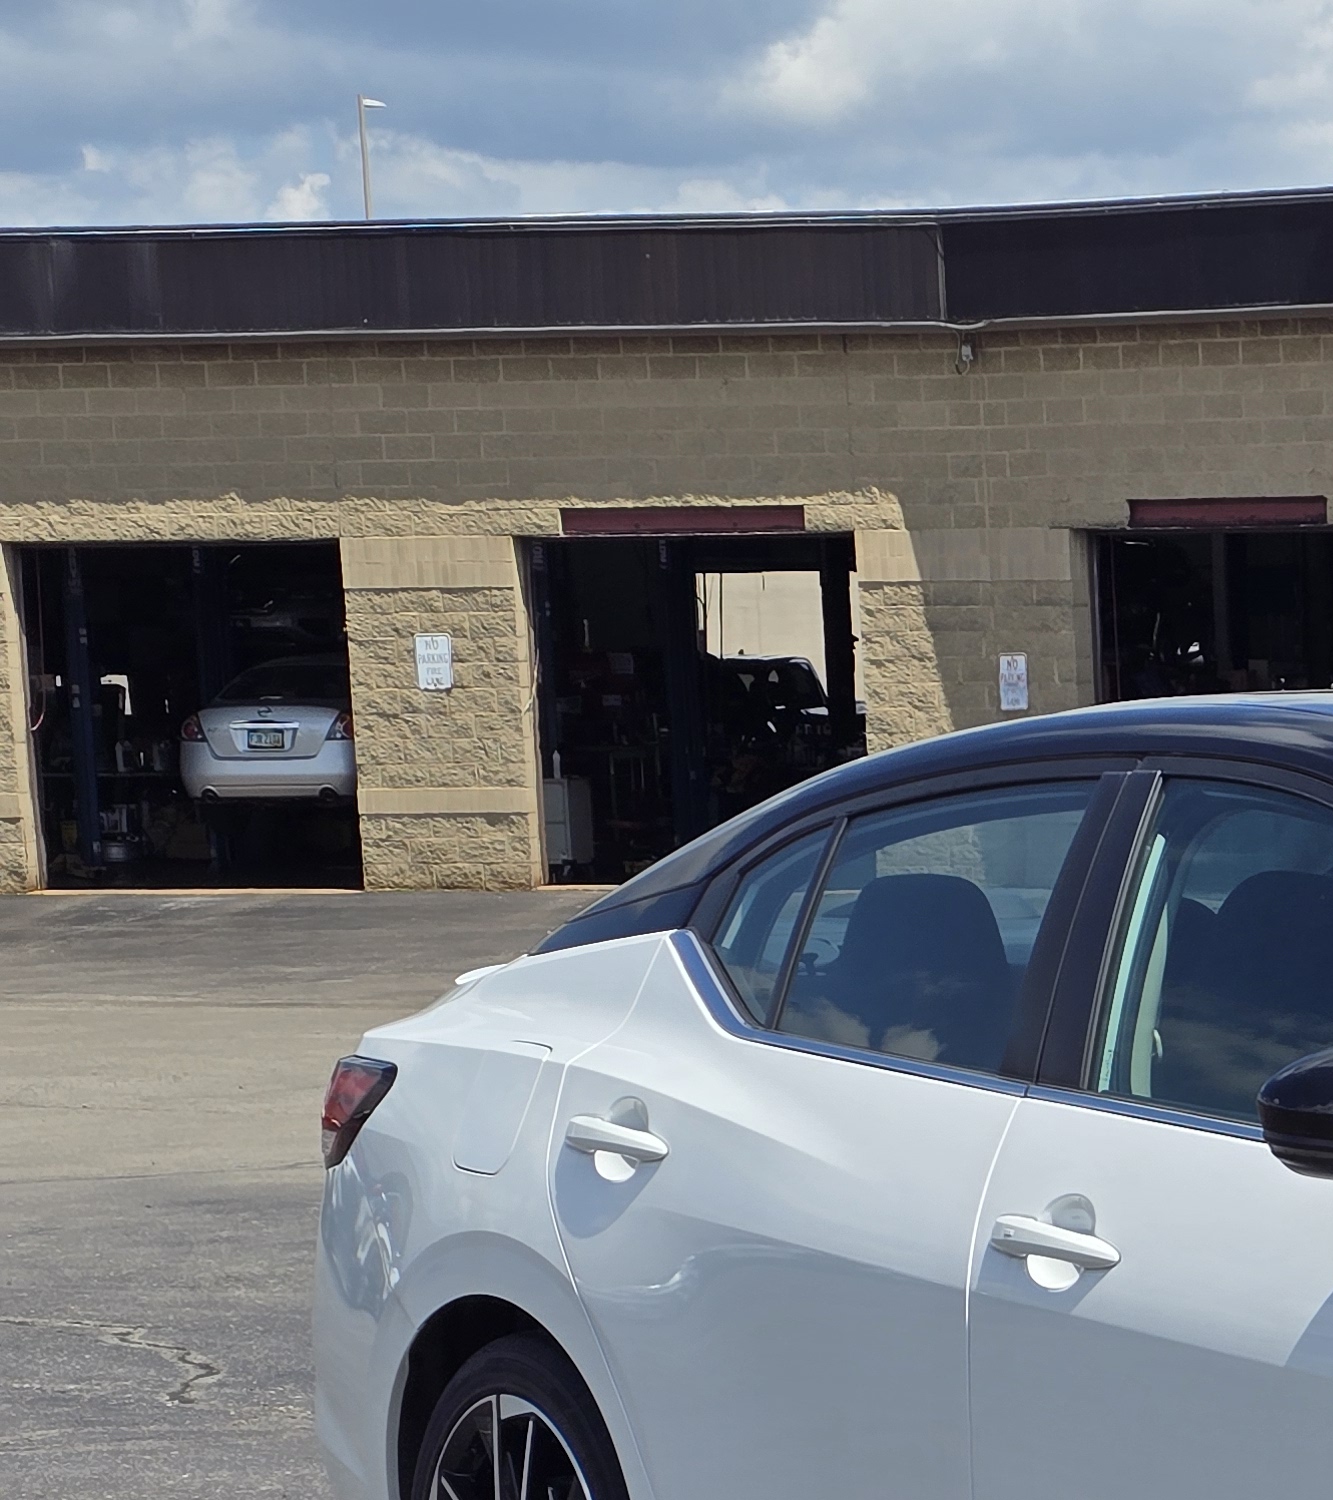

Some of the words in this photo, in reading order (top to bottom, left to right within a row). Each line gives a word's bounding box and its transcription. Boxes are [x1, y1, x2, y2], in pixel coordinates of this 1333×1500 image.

[424, 638, 440, 651] NO
[418, 653, 449, 664] PARKING
[1006, 659, 1019, 671] NO
